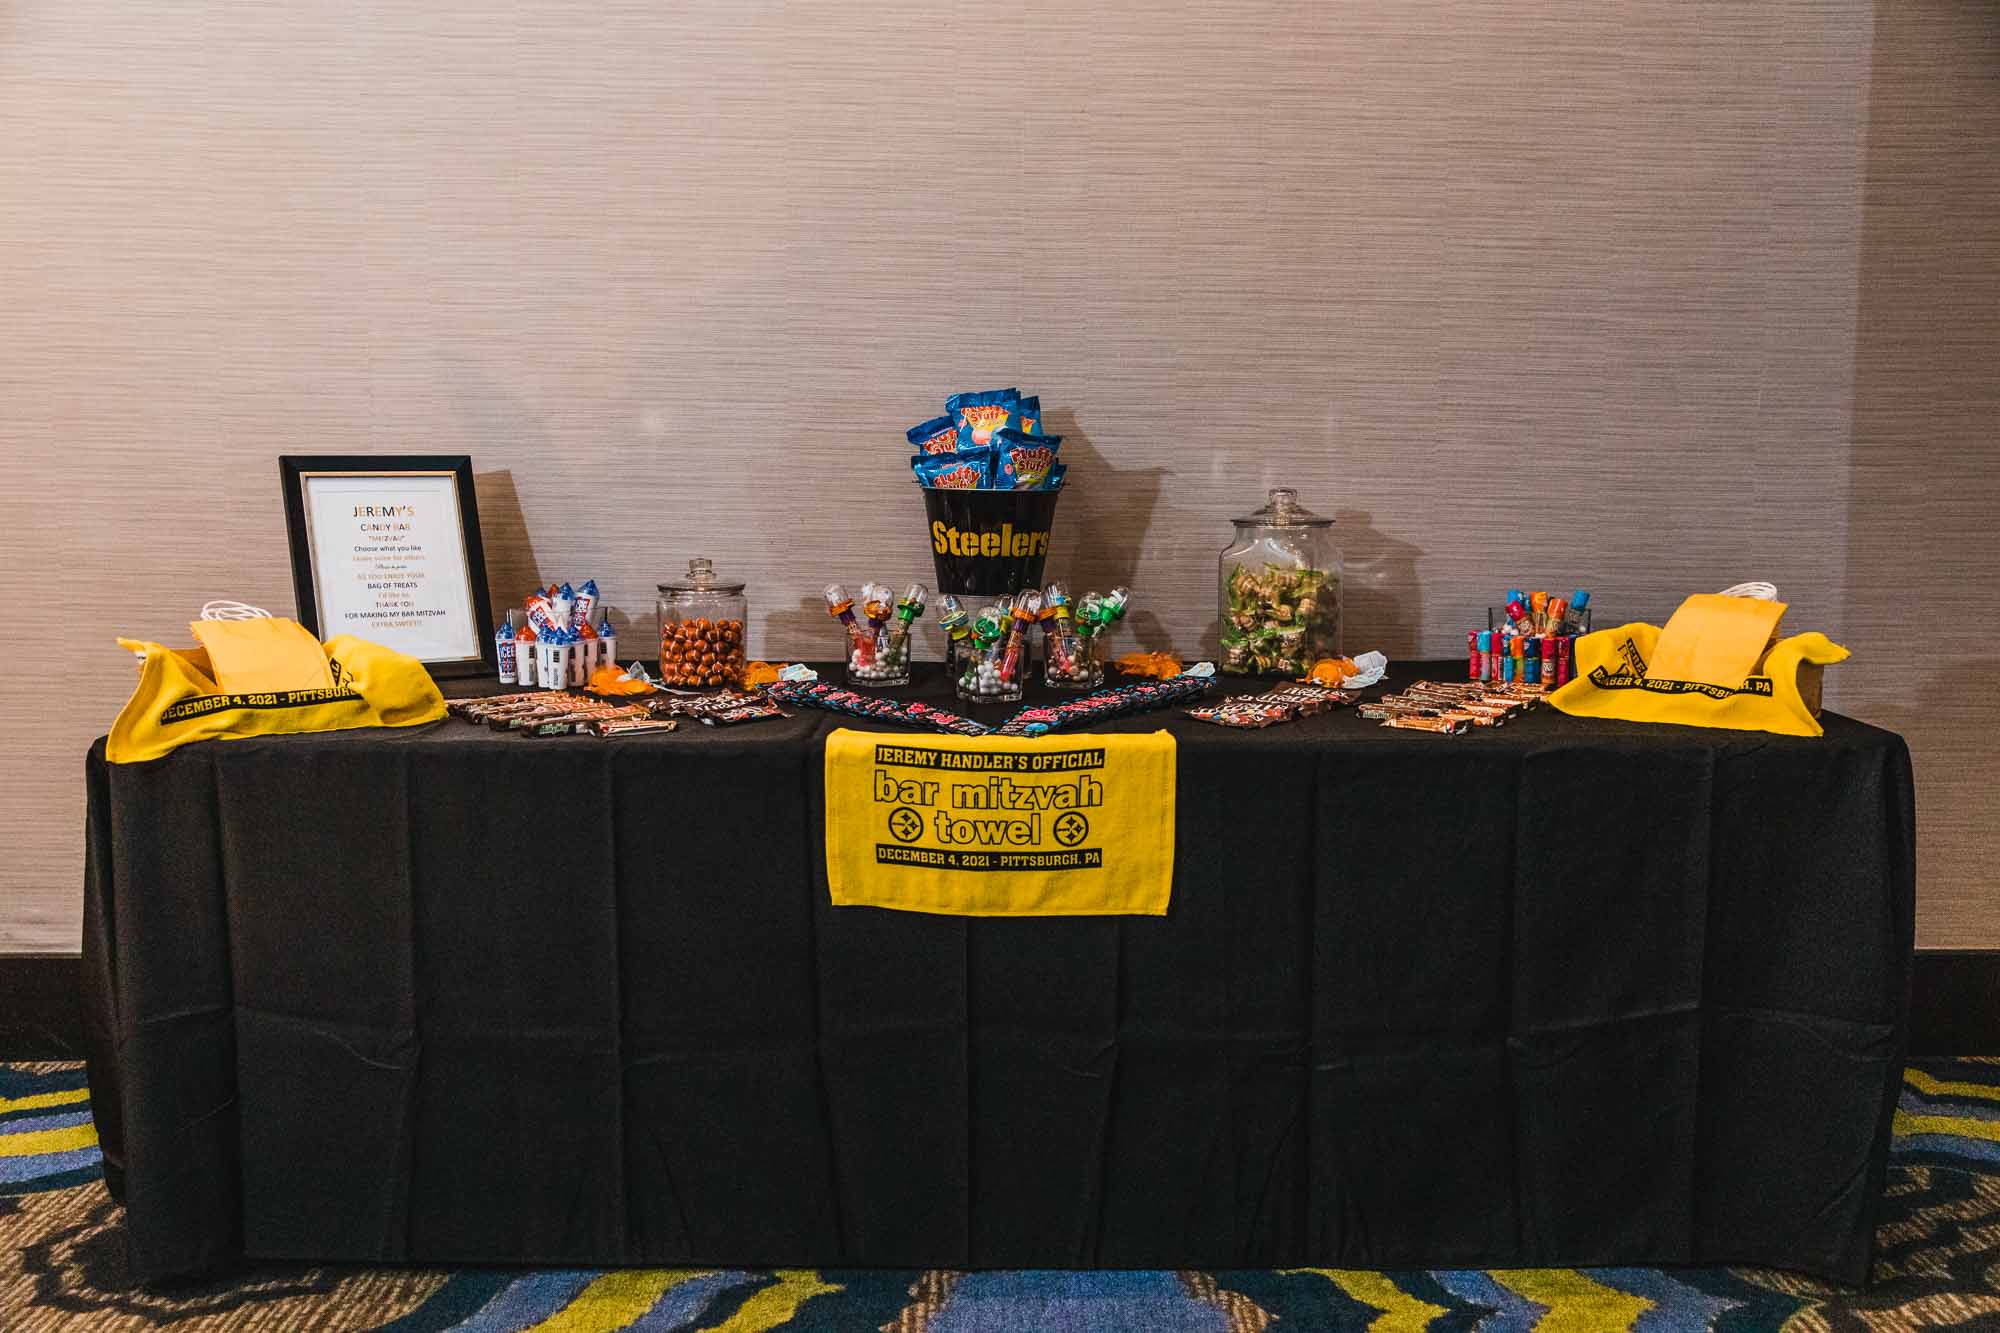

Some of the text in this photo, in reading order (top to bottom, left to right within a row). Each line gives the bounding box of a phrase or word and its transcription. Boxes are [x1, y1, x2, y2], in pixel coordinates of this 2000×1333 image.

[353, 505, 416, 518] JEREMY'S
[360, 523, 391, 531] CANDY
[932, 520, 1050, 558] Steelers
[1646, 680, 1674, 690] 2021
[1756, 681, 1771, 692] PA
[248, 694, 278, 705] 2021
[877, 747, 1102, 770] JEREMY HANDLER'S OFFICIAL
[874, 769, 1103, 810] bar mitzvah
[934, 810, 1041, 845] towel
[877, 847, 945, 865] DECEMBER
[962, 855, 990, 867] 2021
[1085, 851, 1100, 864] PA
